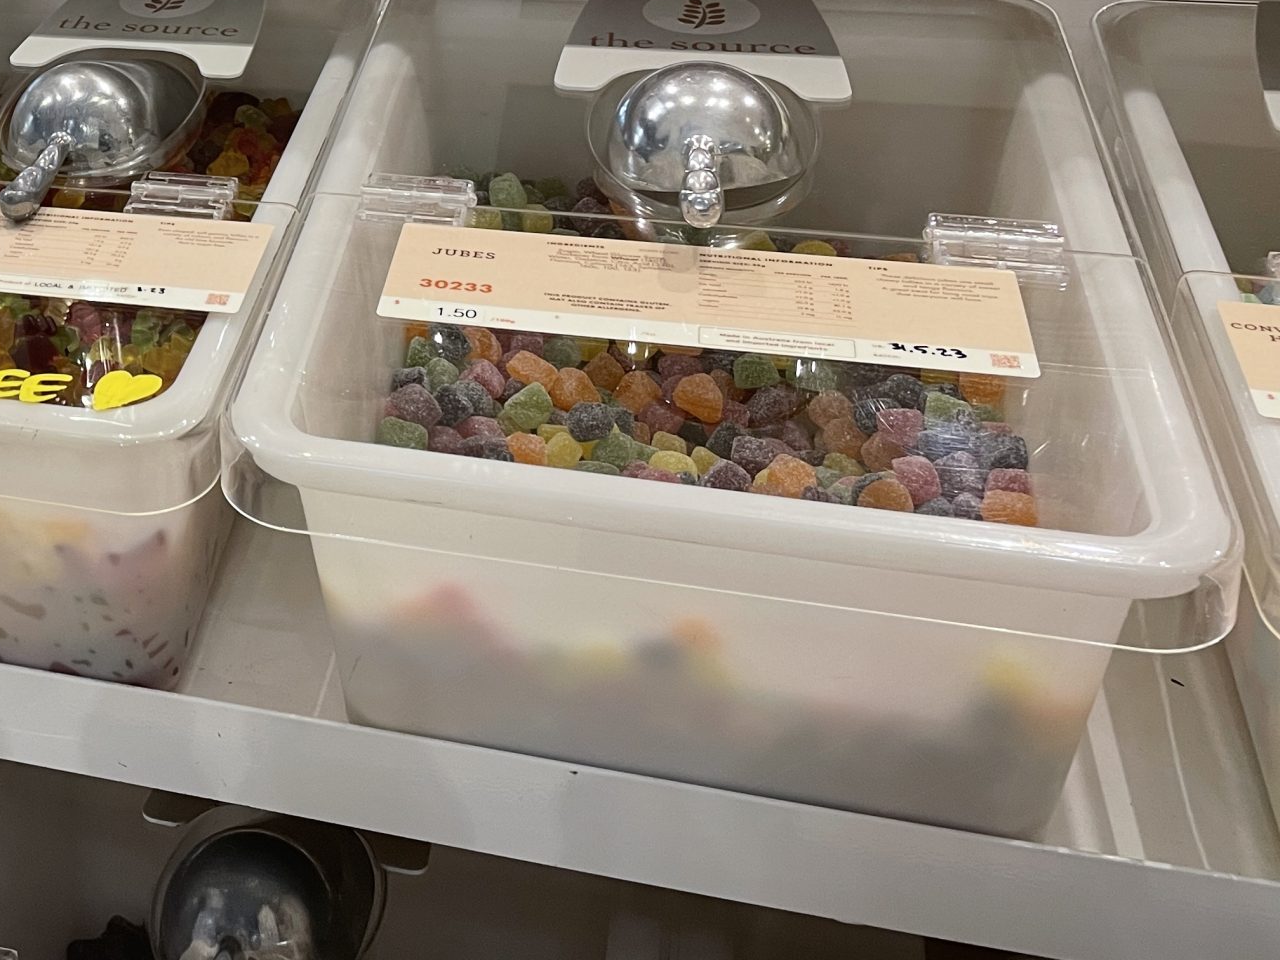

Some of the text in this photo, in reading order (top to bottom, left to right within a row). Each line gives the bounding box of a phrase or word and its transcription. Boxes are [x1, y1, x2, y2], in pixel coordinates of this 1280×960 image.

[58, 15, 239, 37] the source
[590, 32, 817, 55] the source
[432, 248, 496, 260] JUBES
[419, 278, 493, 293] 30233
[437, 307, 477, 319] 1.50
